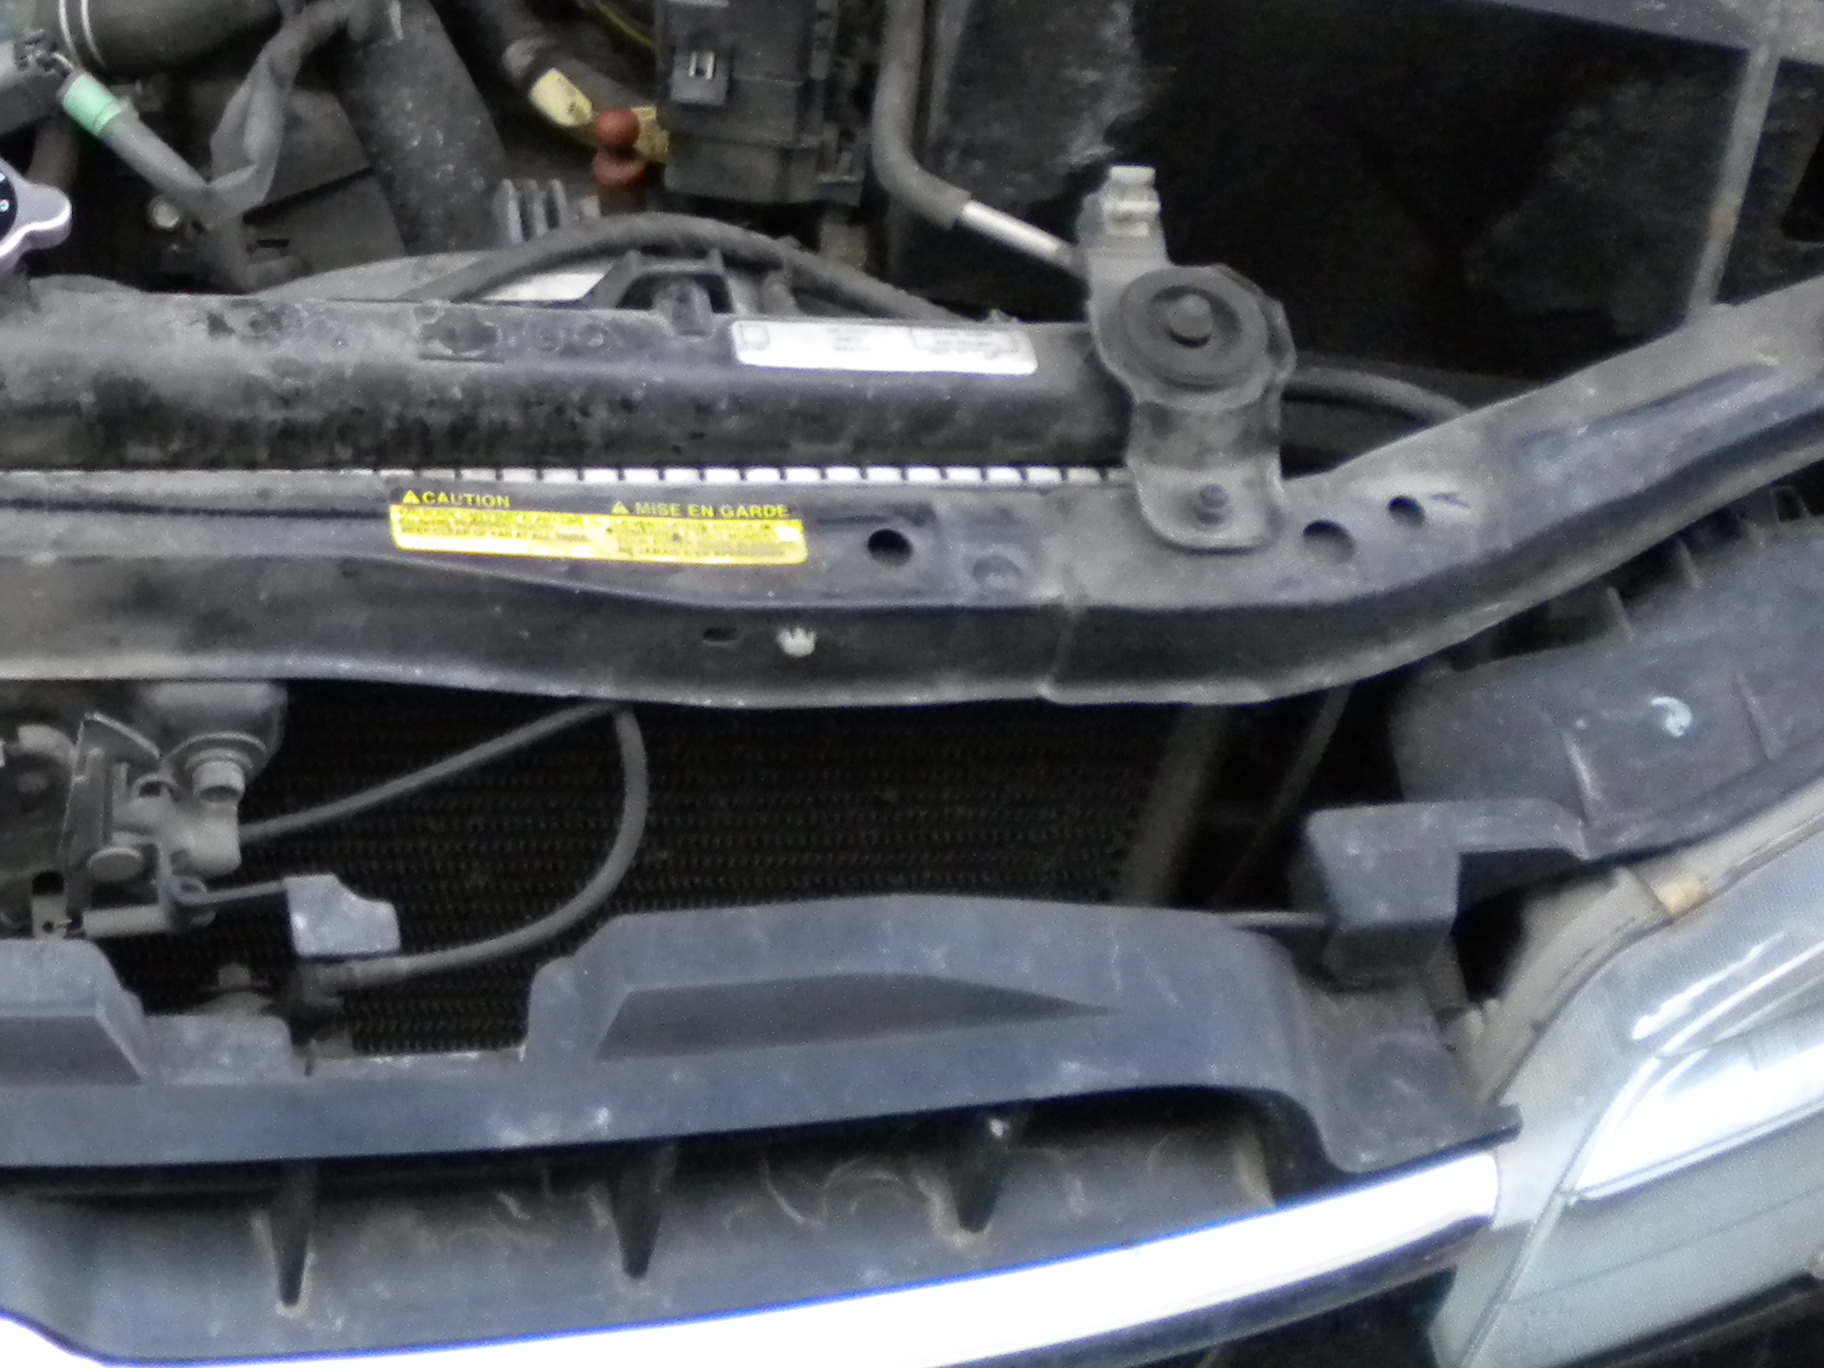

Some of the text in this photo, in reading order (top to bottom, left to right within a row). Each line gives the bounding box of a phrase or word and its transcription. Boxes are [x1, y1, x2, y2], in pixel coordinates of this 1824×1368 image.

[422, 492, 510, 508] CAUTION
[634, 502, 790, 519] MISE EN GARDE
